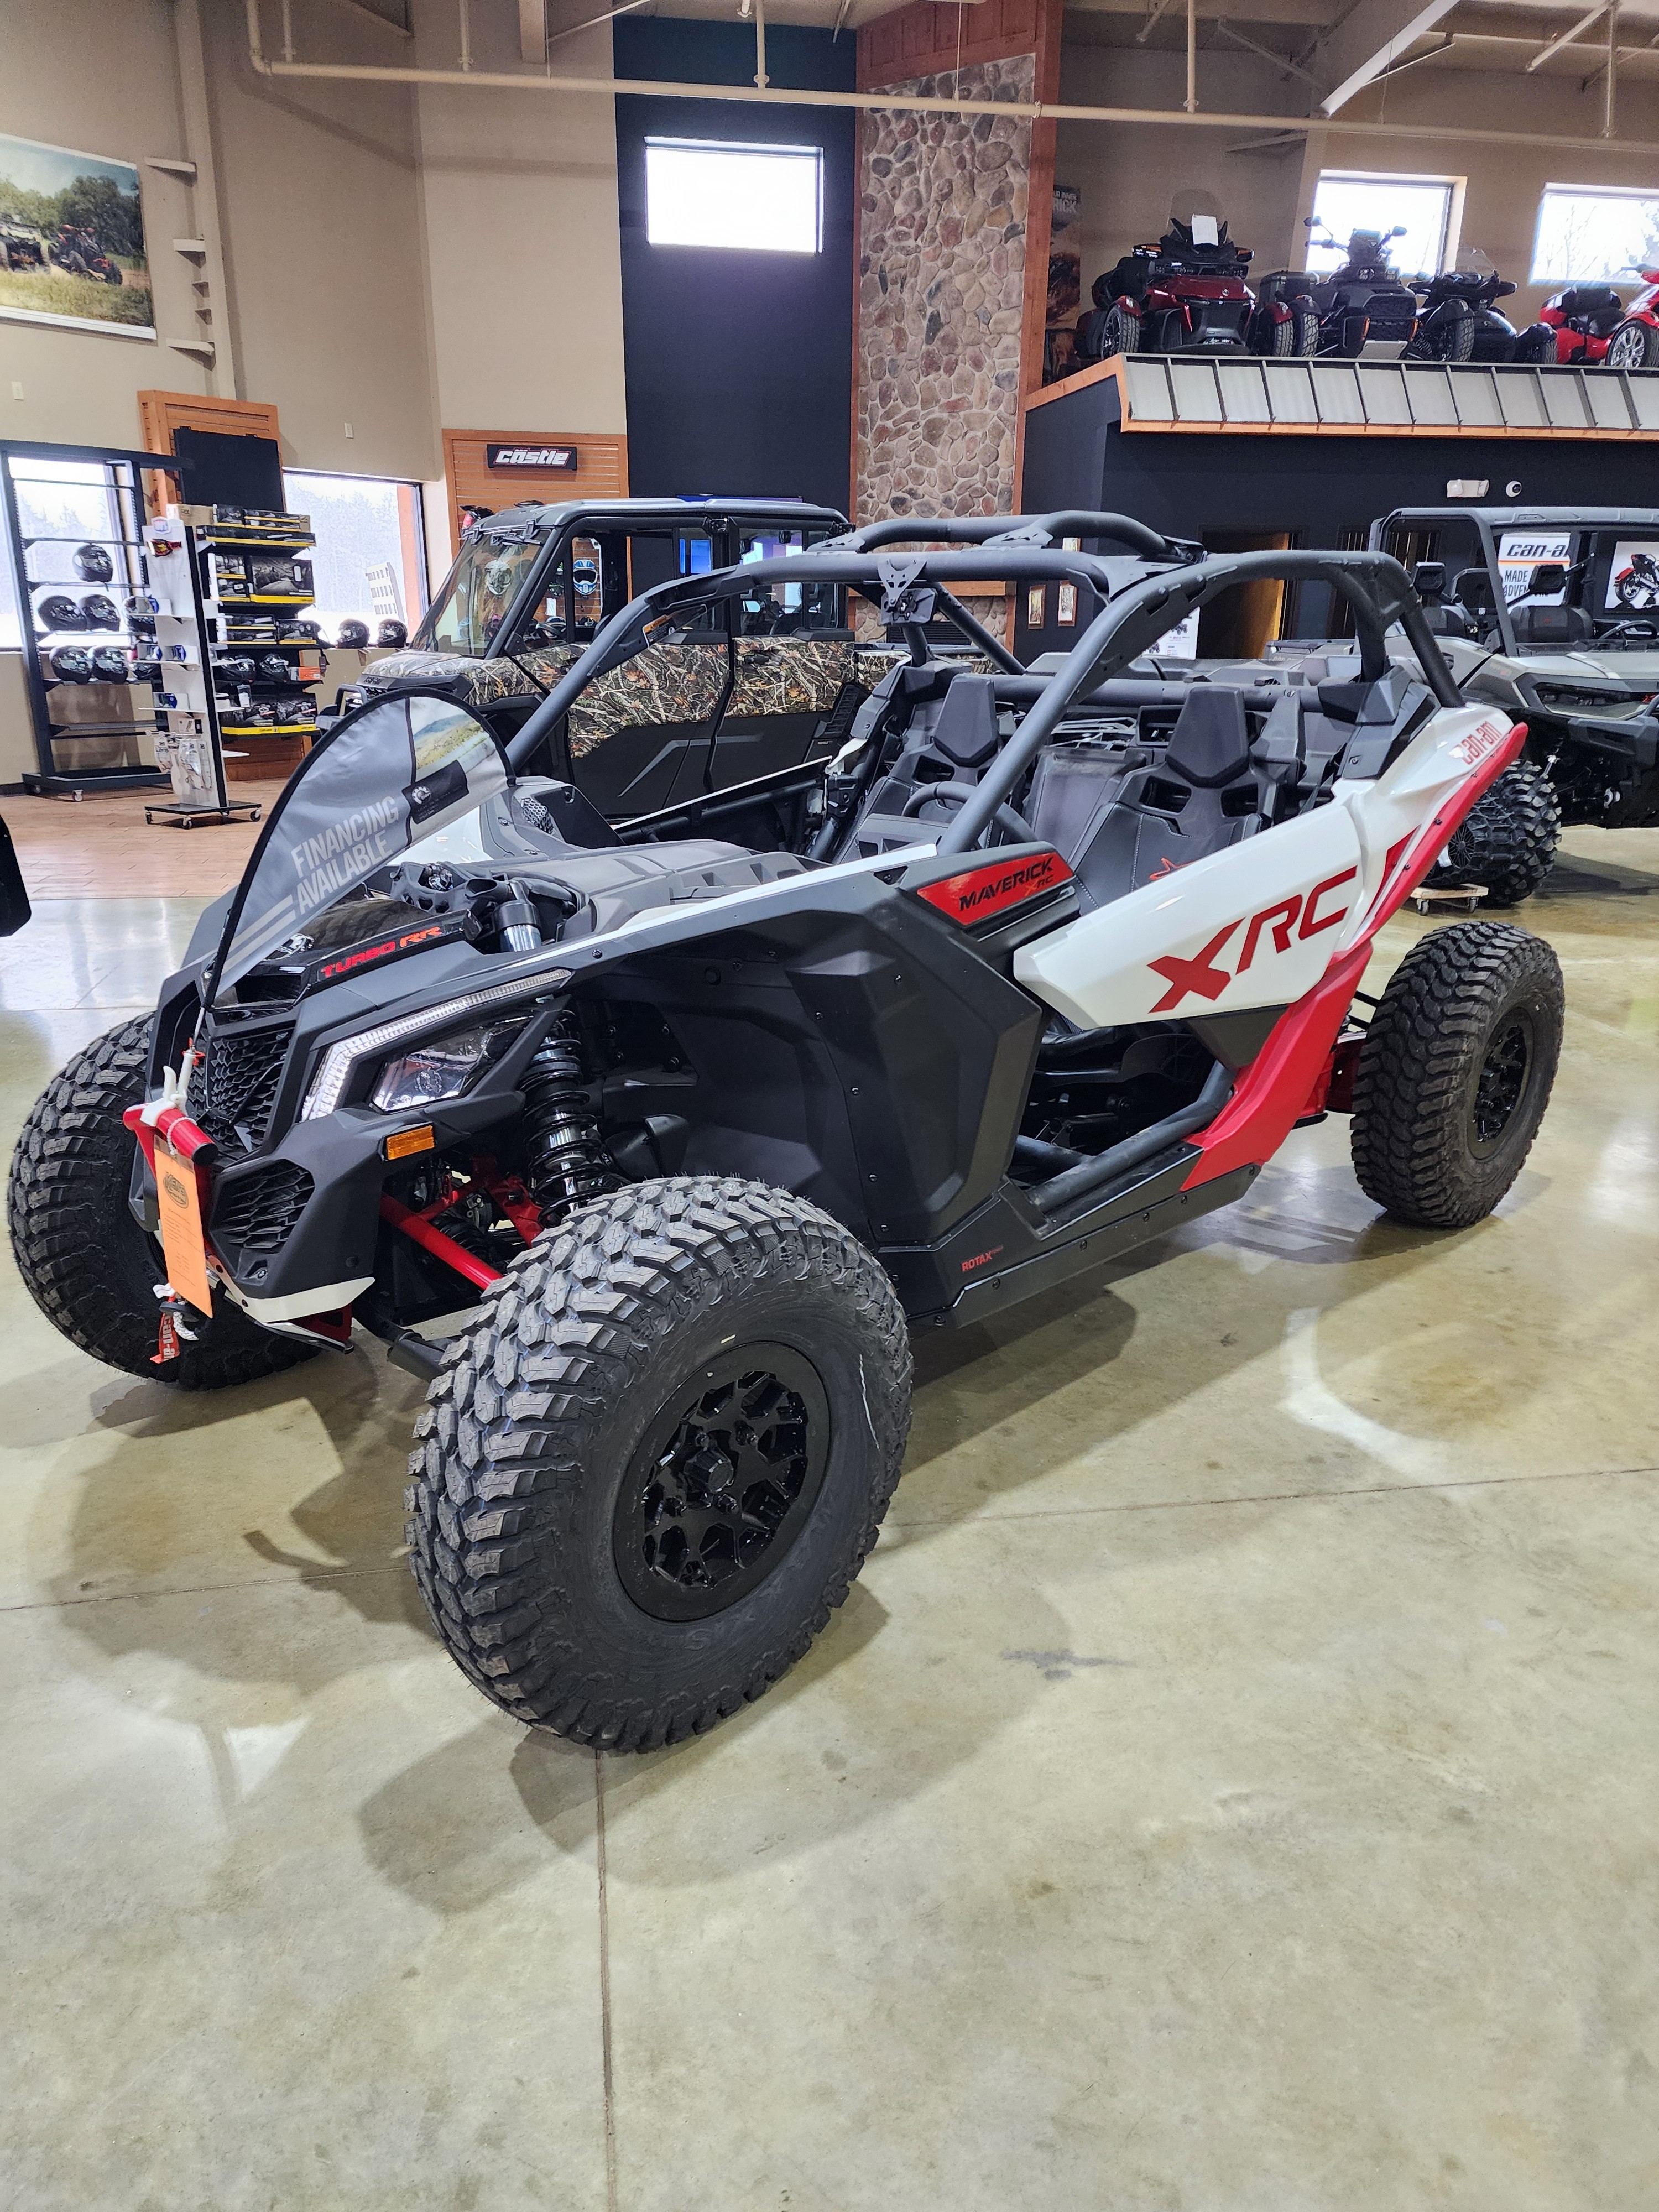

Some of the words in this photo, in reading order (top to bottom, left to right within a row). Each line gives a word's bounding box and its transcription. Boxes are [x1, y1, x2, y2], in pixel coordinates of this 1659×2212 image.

[1053, 198, 1077, 213] RICK
[1507, 544, 1569, 557] can-a
[1504, 570, 1528, 582] MADE
[290, 796, 399, 878] FINANCING
[296, 829, 393, 915] AVAILABLE
[959, 857, 1053, 912] MAVERICK
[1024, 875, 1053, 896] XRC
[320, 941, 396, 978] TURBO
[399, 926, 443, 948] RR
[1147, 865, 1357, 1014] XRC
[961, 1252, 992, 1272] ROTAX
